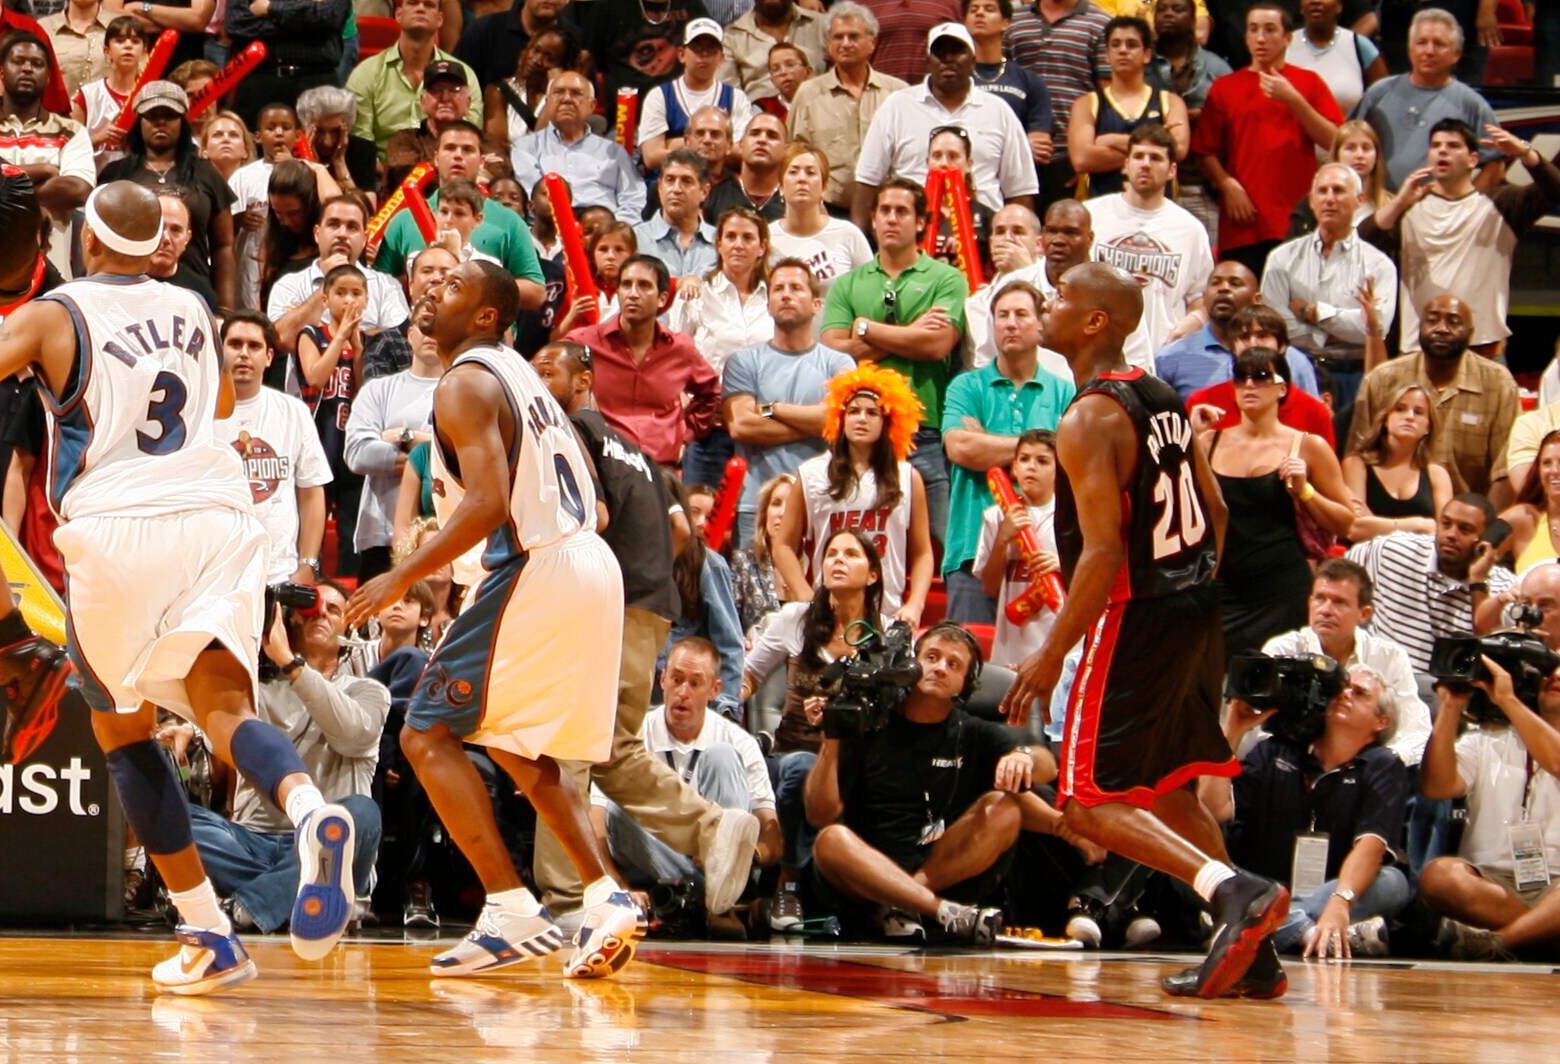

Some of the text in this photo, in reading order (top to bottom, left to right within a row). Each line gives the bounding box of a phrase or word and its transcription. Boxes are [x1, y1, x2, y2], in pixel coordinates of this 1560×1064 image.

[1095, 243, 1183, 289] CHAMPIONS
[134, 370, 188, 457] 3
[242, 454, 290, 481] PIONS
[553, 452, 587, 527] 0
[829, 507, 892, 536] HEAT
[1151, 460, 1206, 561] 20
